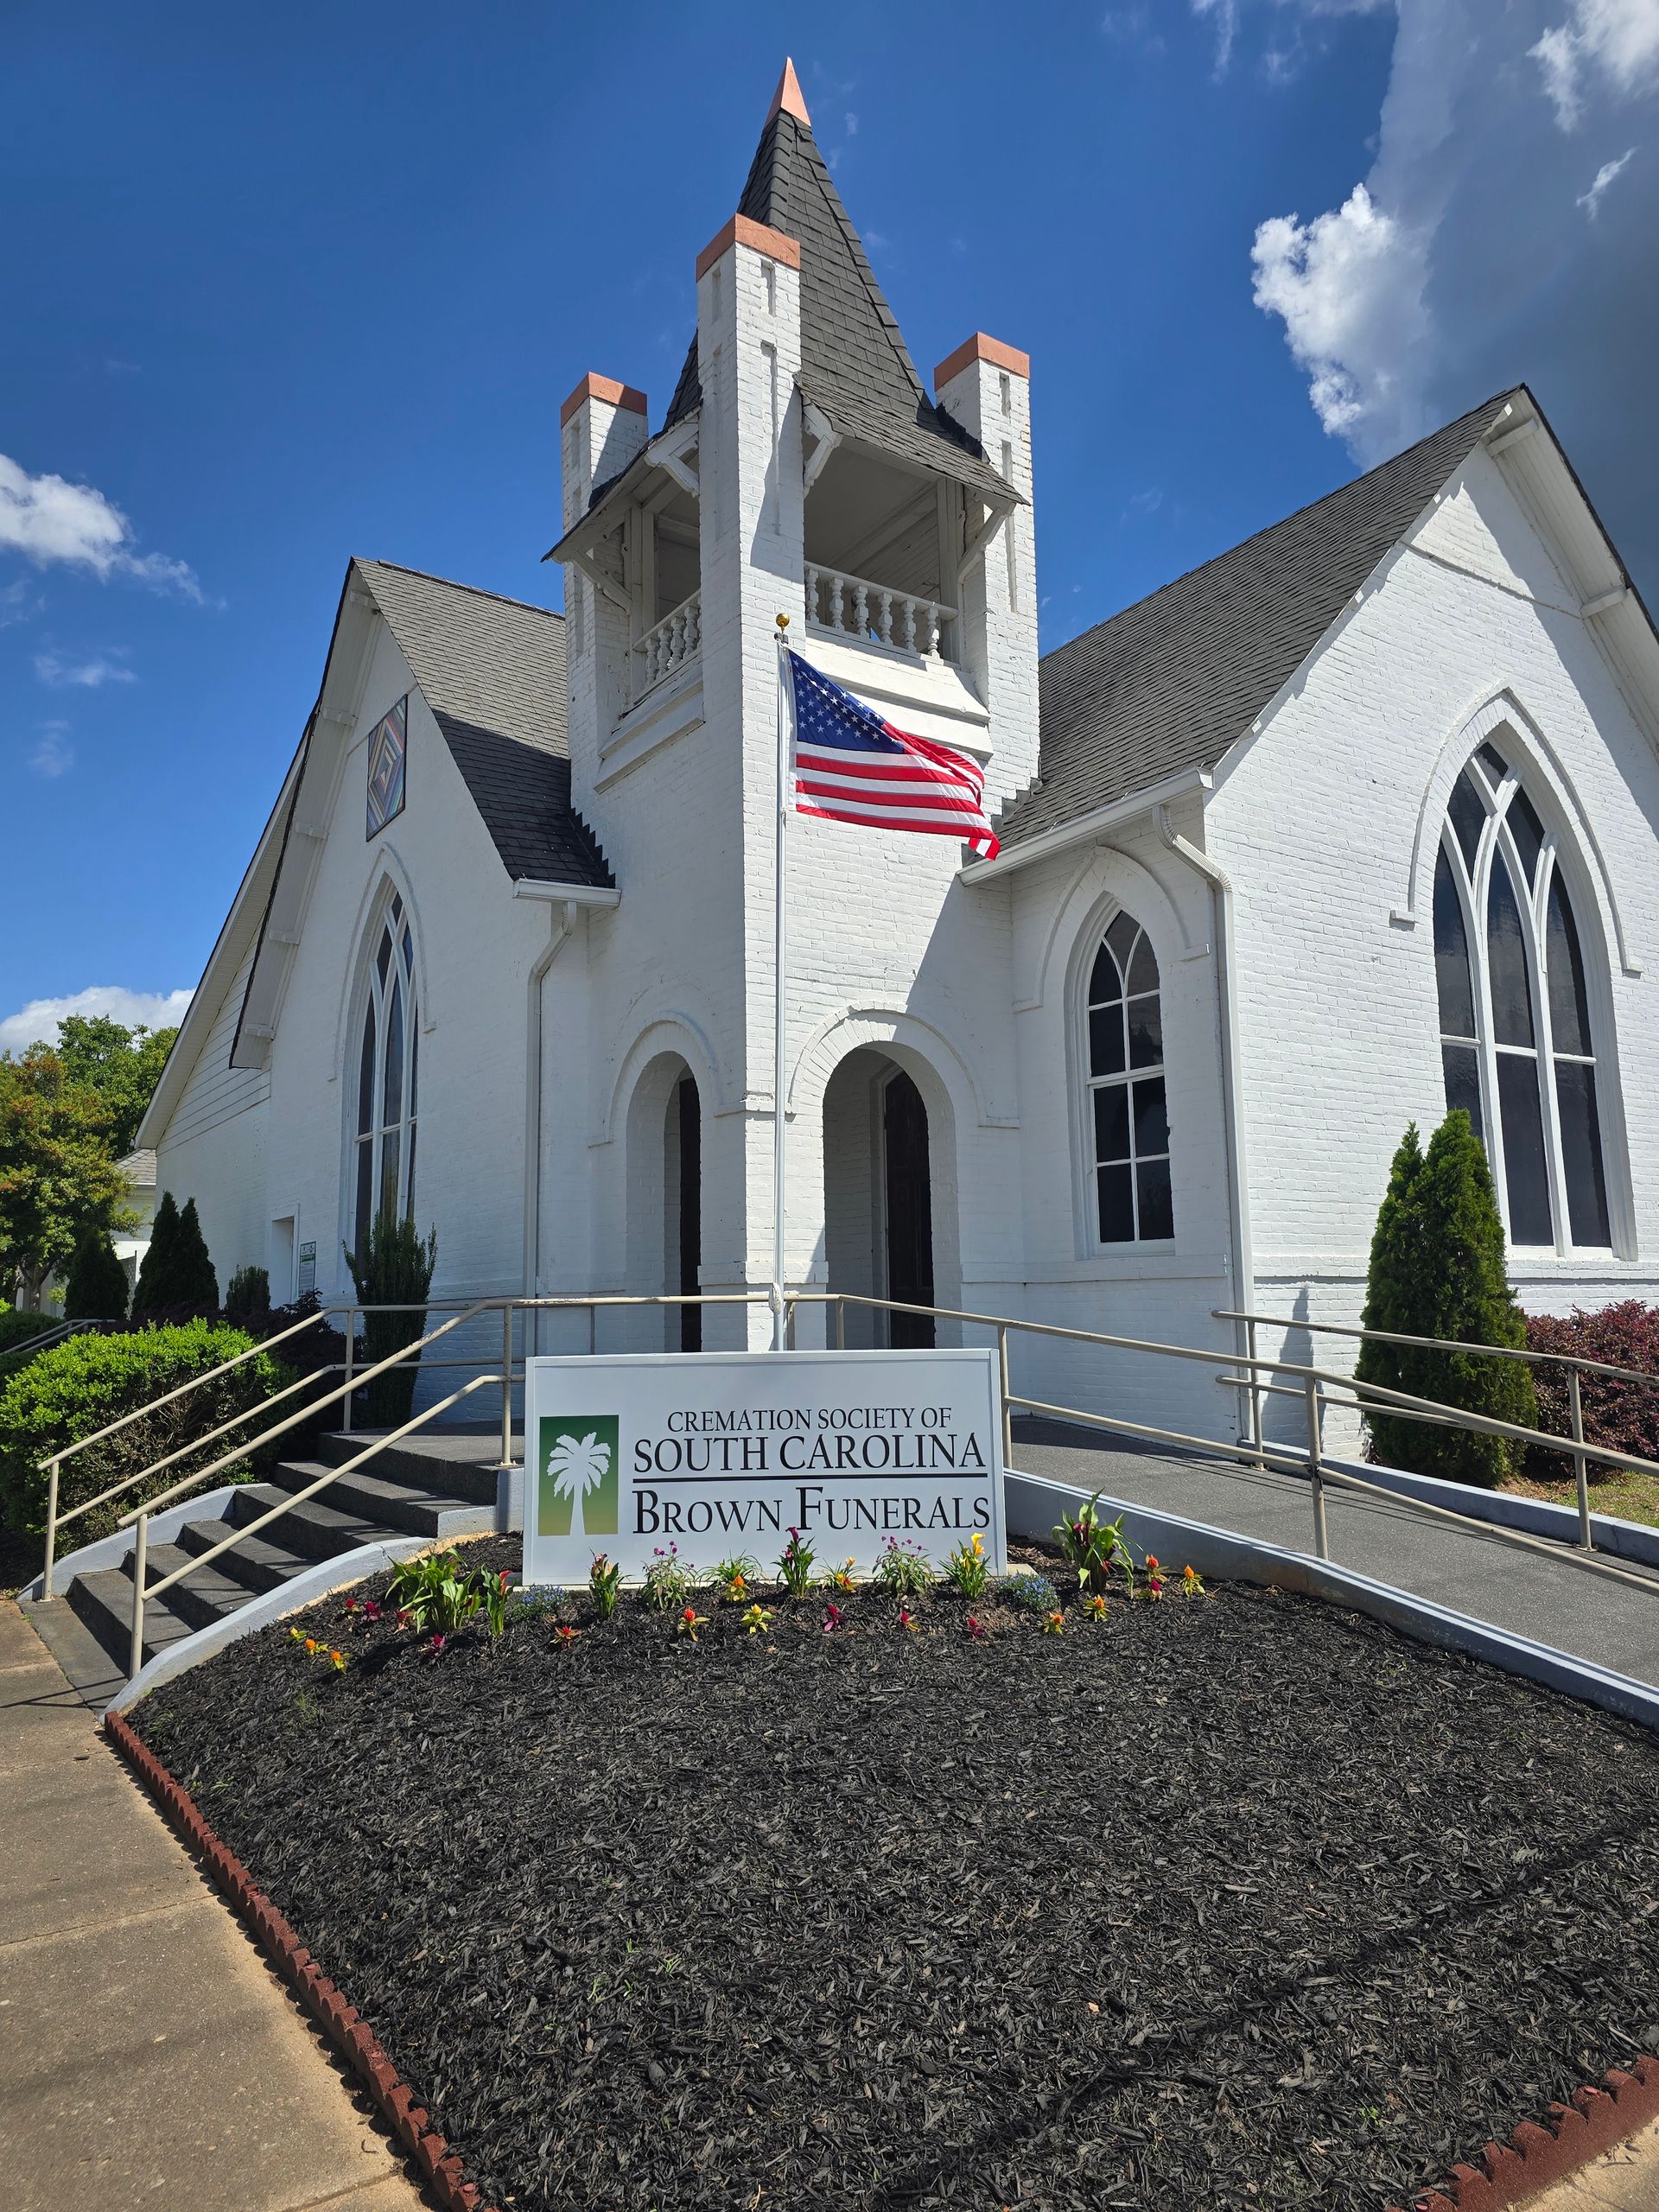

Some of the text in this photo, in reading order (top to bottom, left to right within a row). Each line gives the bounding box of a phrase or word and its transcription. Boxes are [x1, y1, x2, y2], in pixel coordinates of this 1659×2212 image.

[668, 1407, 952, 1431] CREMATION SOCIETY OF
[634, 1432, 986, 1473] SOUTH CAROLINA
[632, 1486, 990, 1534] BROWN FUNERALS
